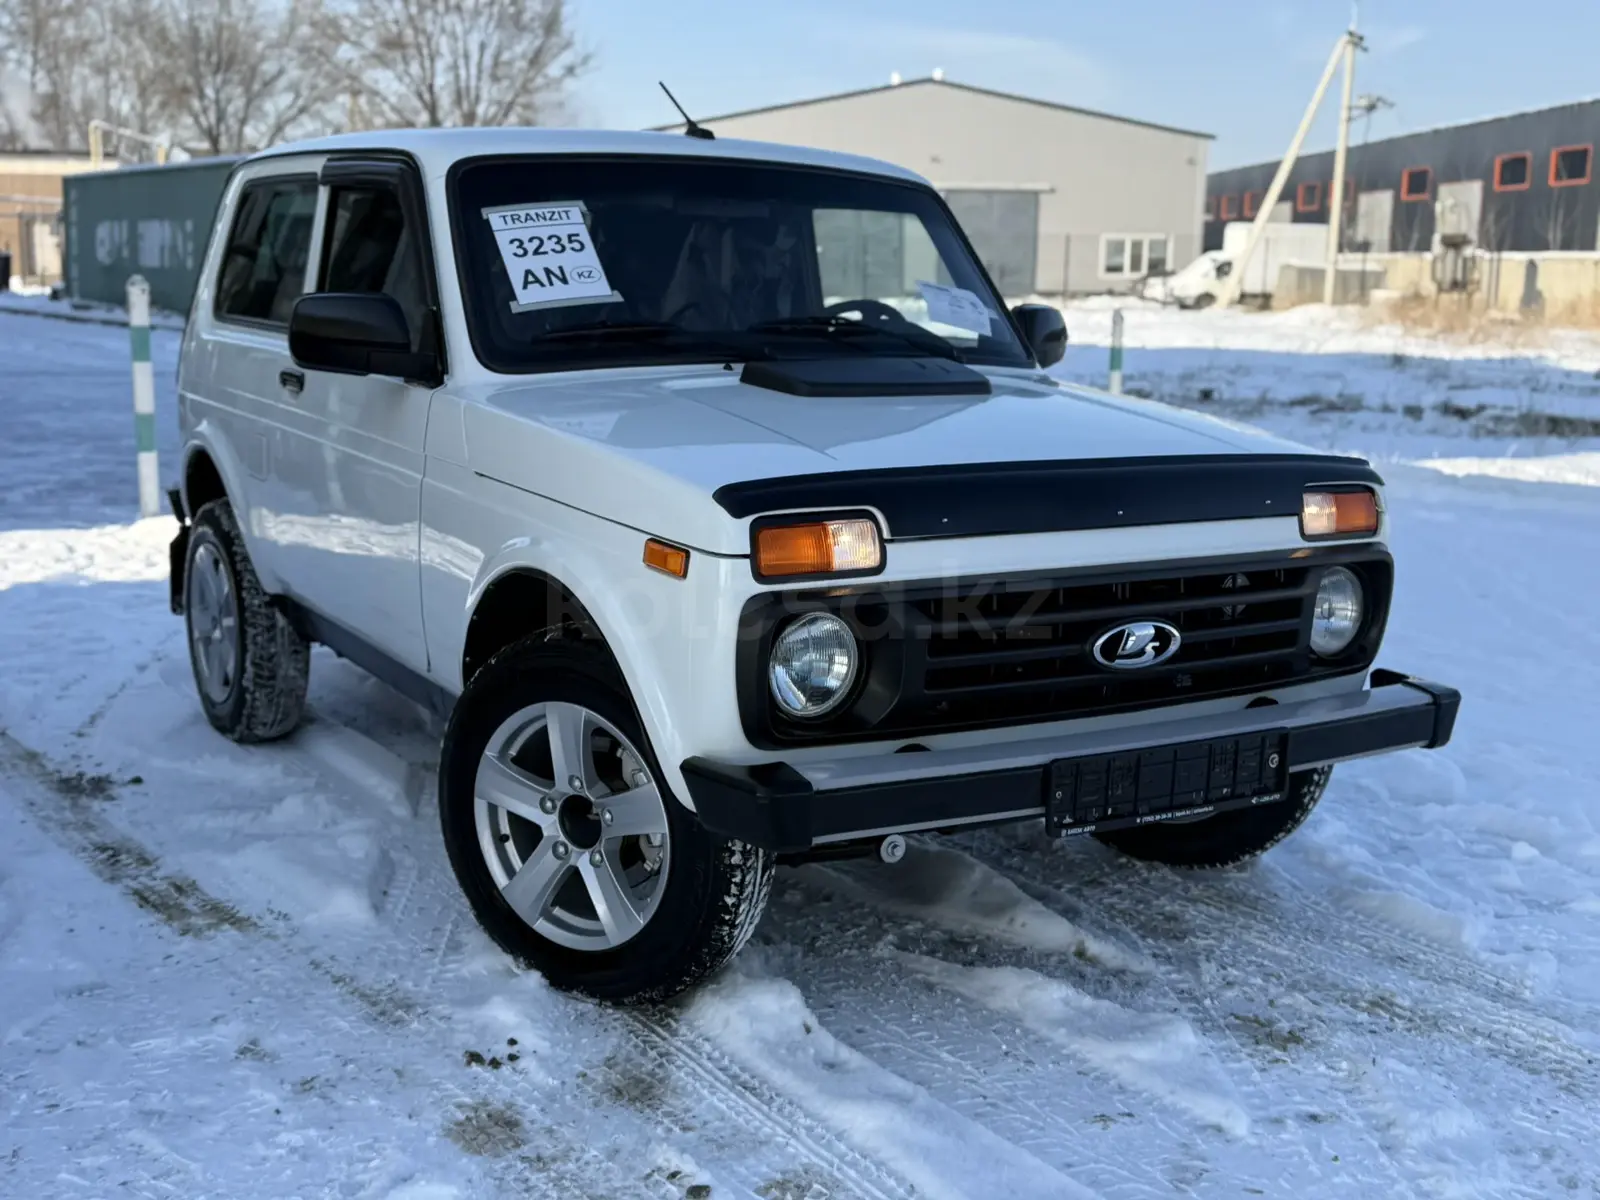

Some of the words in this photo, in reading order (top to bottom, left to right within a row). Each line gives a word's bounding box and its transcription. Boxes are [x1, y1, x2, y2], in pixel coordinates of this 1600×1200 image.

[499, 210, 572, 226] TRANZIT
[508, 233, 586, 258] 3235
[522, 265, 570, 290] AN
[577, 270, 595, 279] KZ
